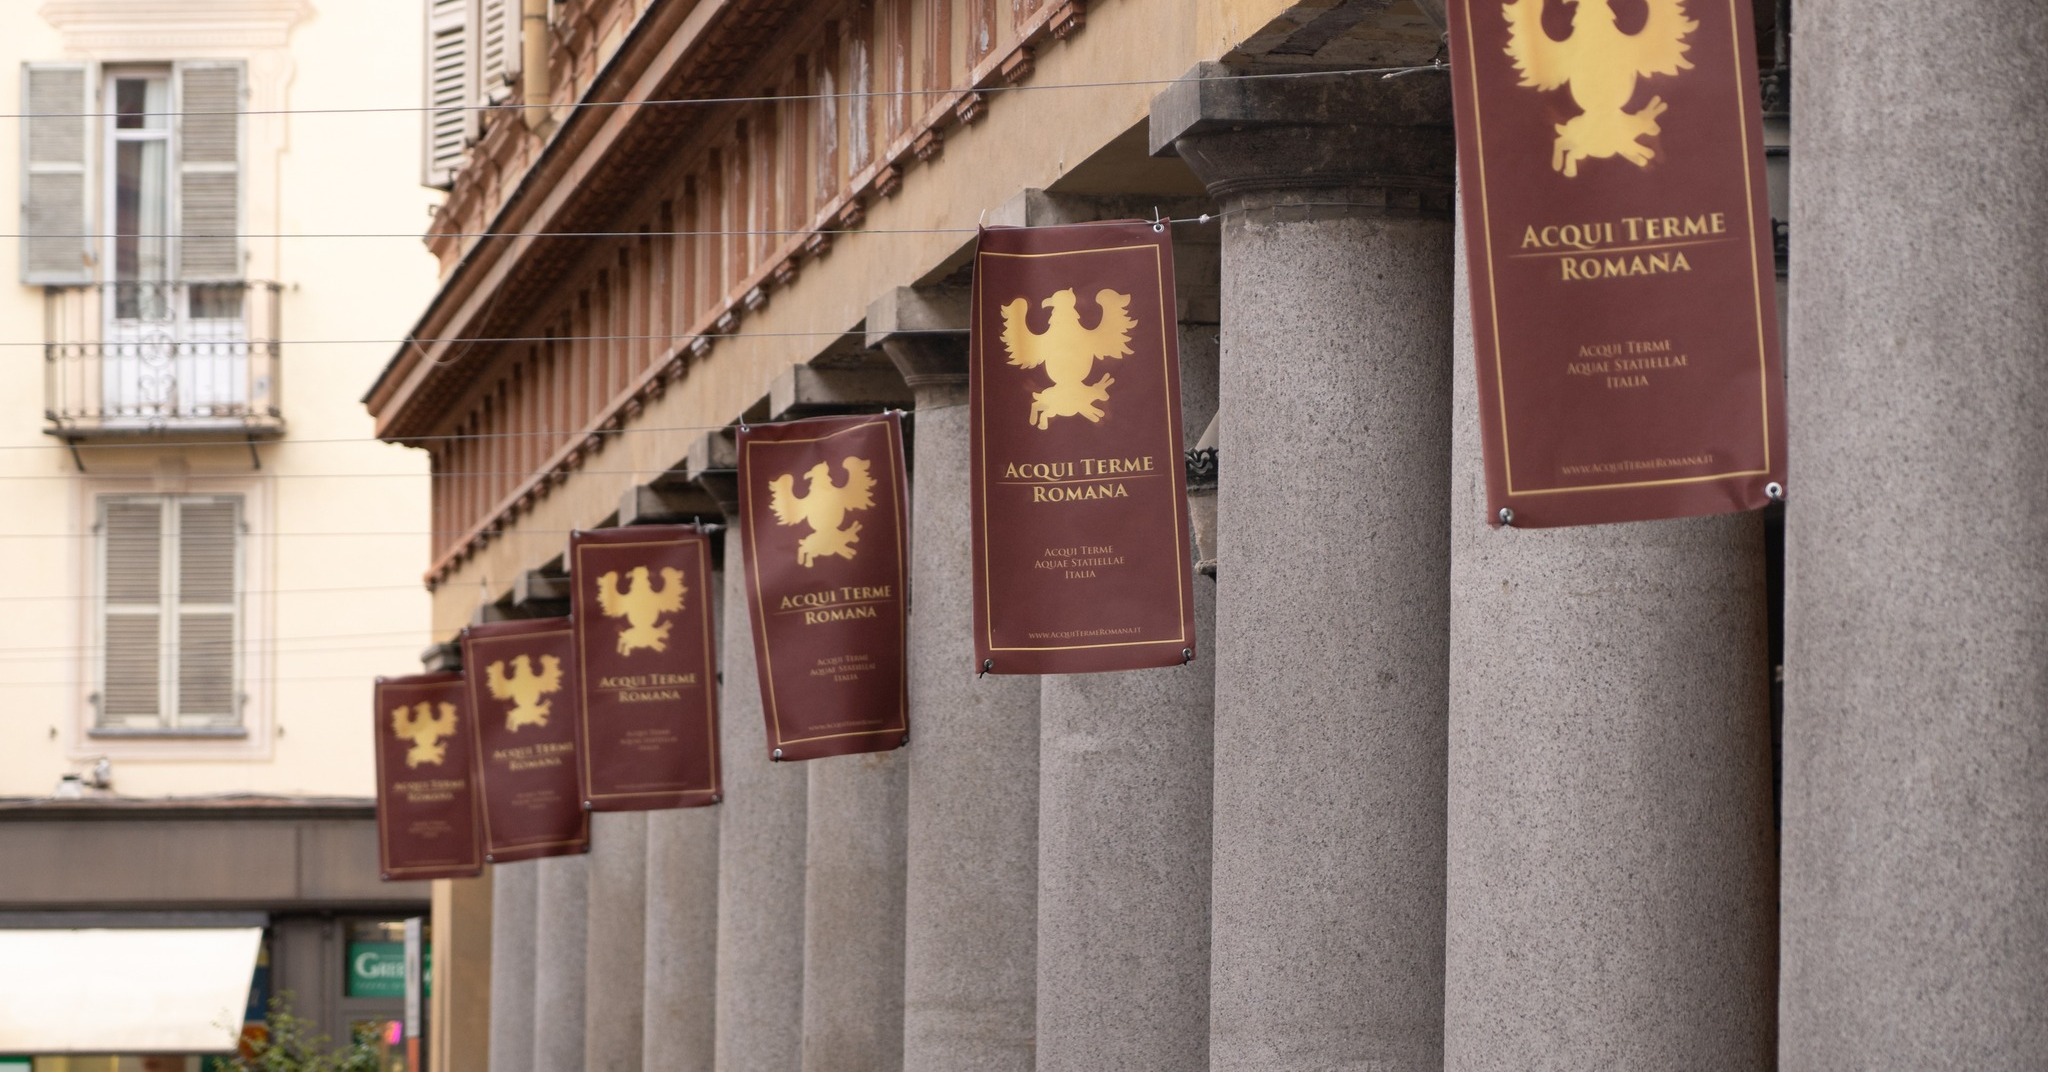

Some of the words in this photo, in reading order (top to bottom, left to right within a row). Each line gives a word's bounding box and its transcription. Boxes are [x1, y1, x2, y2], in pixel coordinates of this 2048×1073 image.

[1520, 222, 1614, 250] ACQUI
[1622, 212, 1726, 240] TERME
[1561, 252, 1691, 280] ROMANA
[1579, 344, 1622, 358] ACQUI
[1625, 339, 1672, 354] TERME
[1567, 361, 1609, 375] AQUAE
[1606, 375, 1649, 389] ITALIA
[1004, 461, 1075, 481] ACQUI
[1080, 456, 1154, 476] TERME
[1033, 483, 1129, 503] ROMANA
[1044, 548, 1078, 558] ACQUI
[1080, 545, 1114, 555] TERME
[1034, 560, 1068, 570] AQUAE
[1071, 556, 1125, 568] STATIELLAE
[1065, 570, 1096, 579] ITALIA
[780, 591, 835, 609] ACQUI
[841, 586, 891, 600] TERME
[805, 607, 876, 624] ROMANA
[599, 675, 647, 689] ACQUI
[649, 672, 697, 686] TERME
[618, 689, 682, 703] ROMANA
